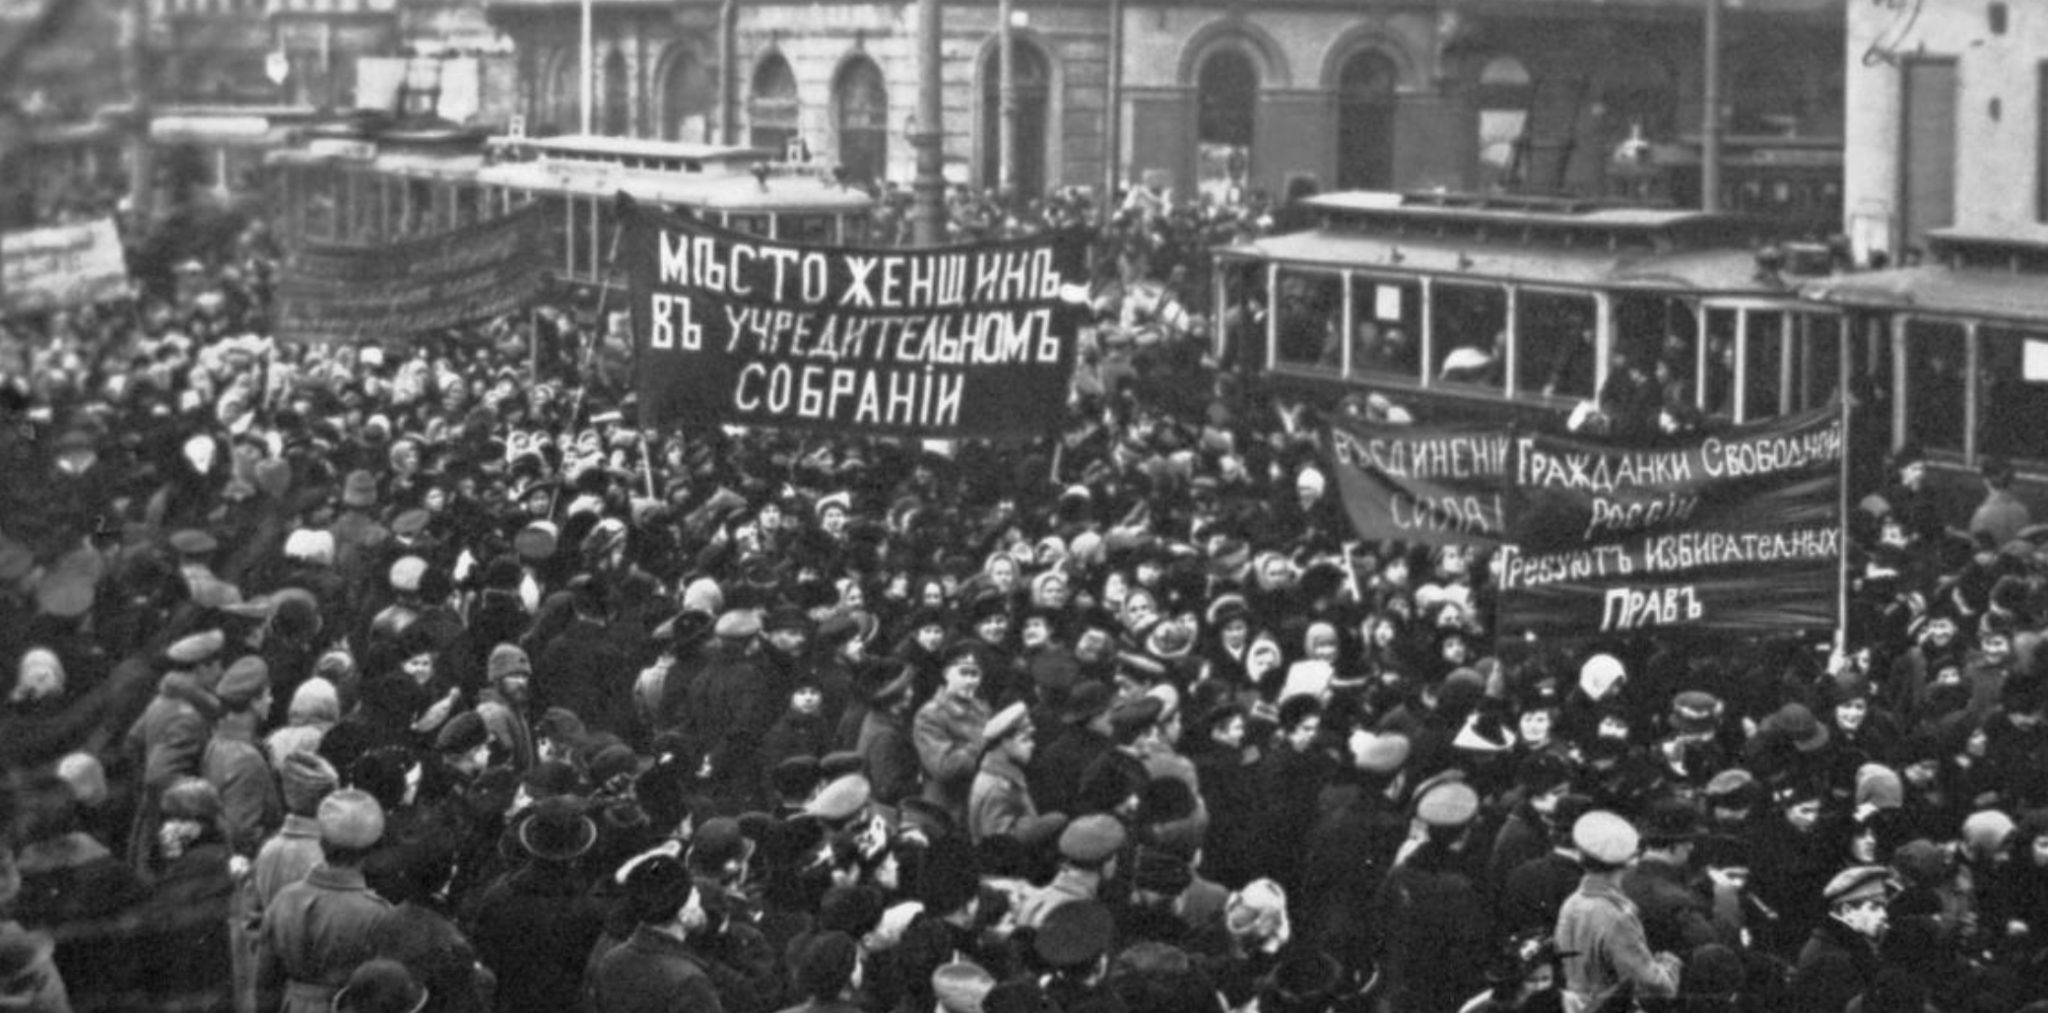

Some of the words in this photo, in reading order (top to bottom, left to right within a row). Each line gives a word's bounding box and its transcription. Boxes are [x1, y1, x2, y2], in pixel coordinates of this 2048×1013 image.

[651, 293, 702, 351] ВЪ
[724, 304, 1060, 364] УЧРЕДИТЕЛЬНОМЪ
[735, 362, 964, 426] СОБРАНІИ
[1516, 438, 1692, 493] ГРАЖДАНКИ
[1602, 585, 1702, 630] ПРАВЪ
